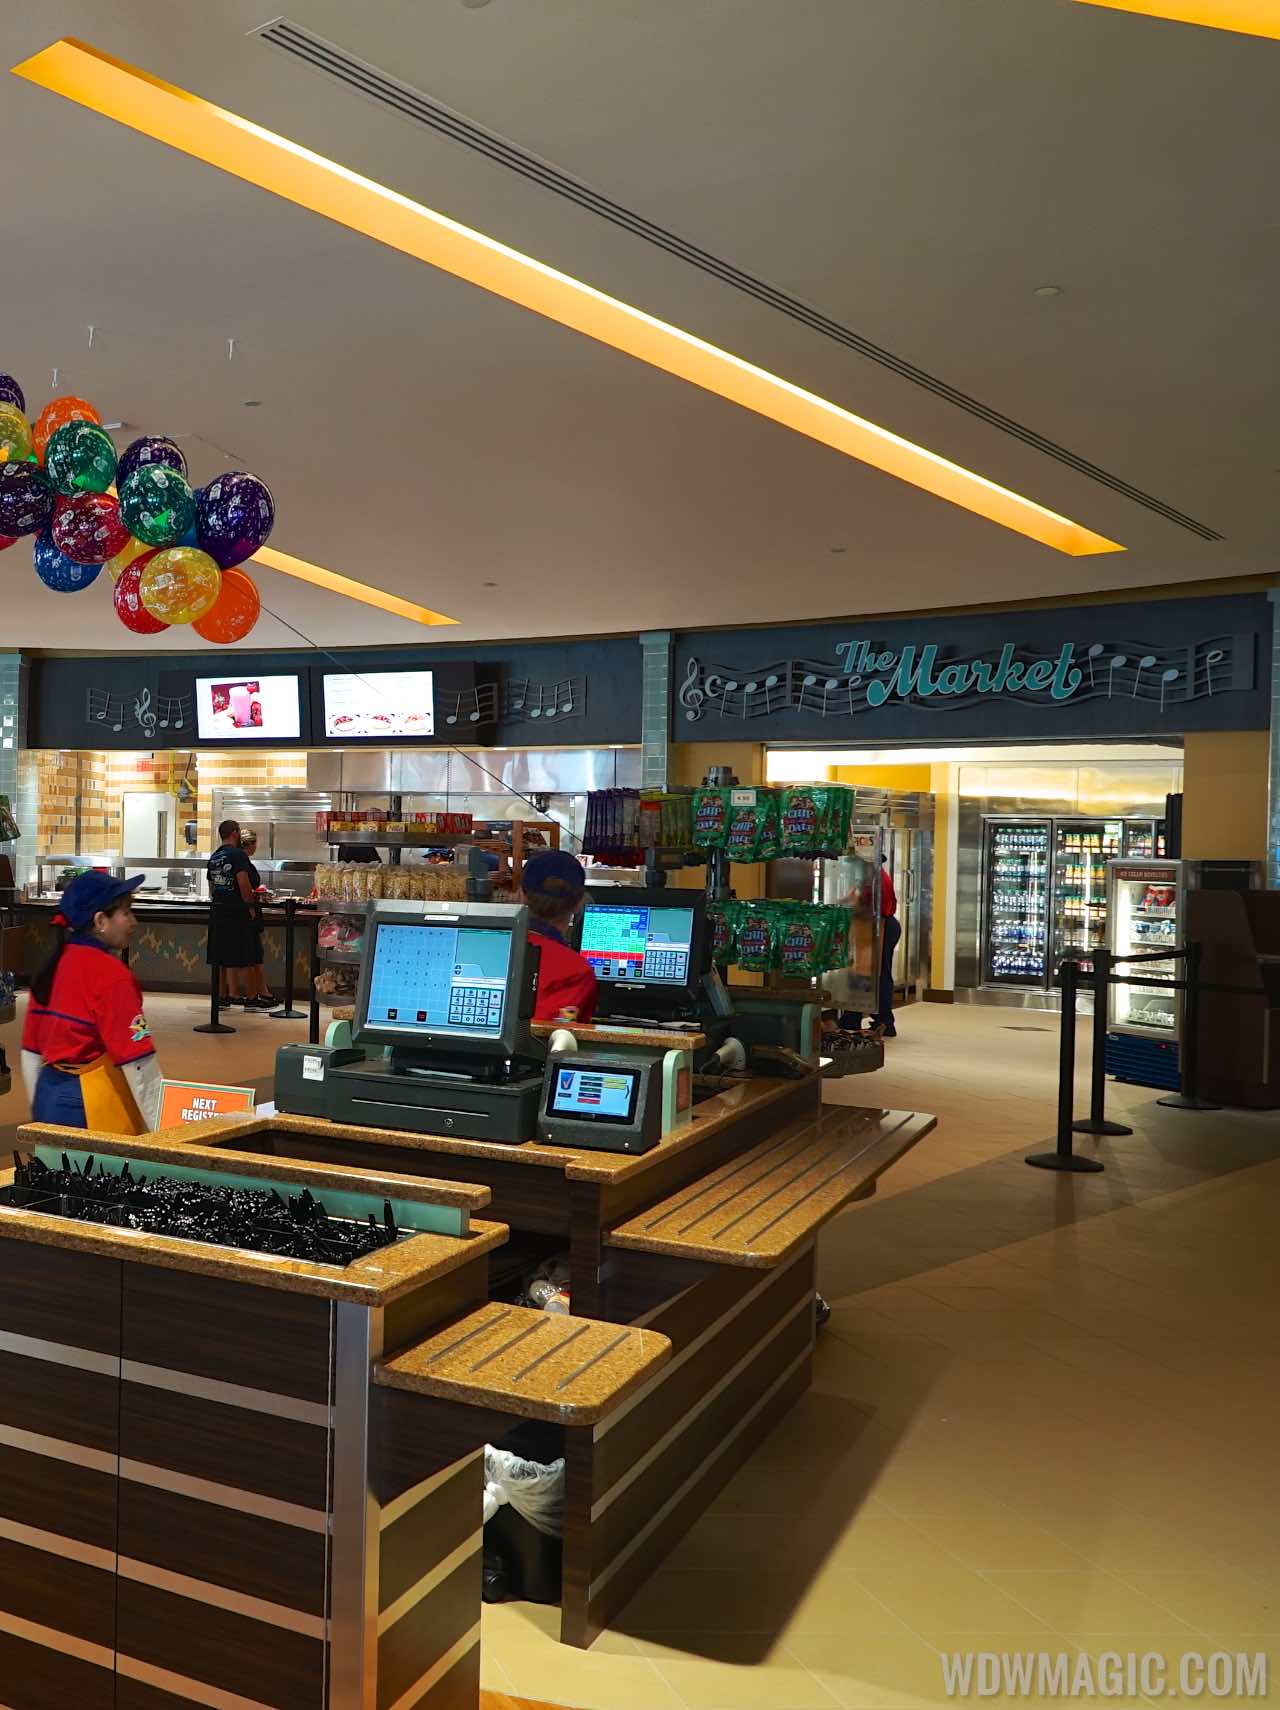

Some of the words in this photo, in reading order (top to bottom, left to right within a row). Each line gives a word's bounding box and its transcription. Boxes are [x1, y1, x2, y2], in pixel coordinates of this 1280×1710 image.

[836, 640, 898, 673] The
[866, 643, 1083, 706] Market
[181, 1107, 225, 1121] REGIST
[192, 1097, 217, 1111] NEXT
